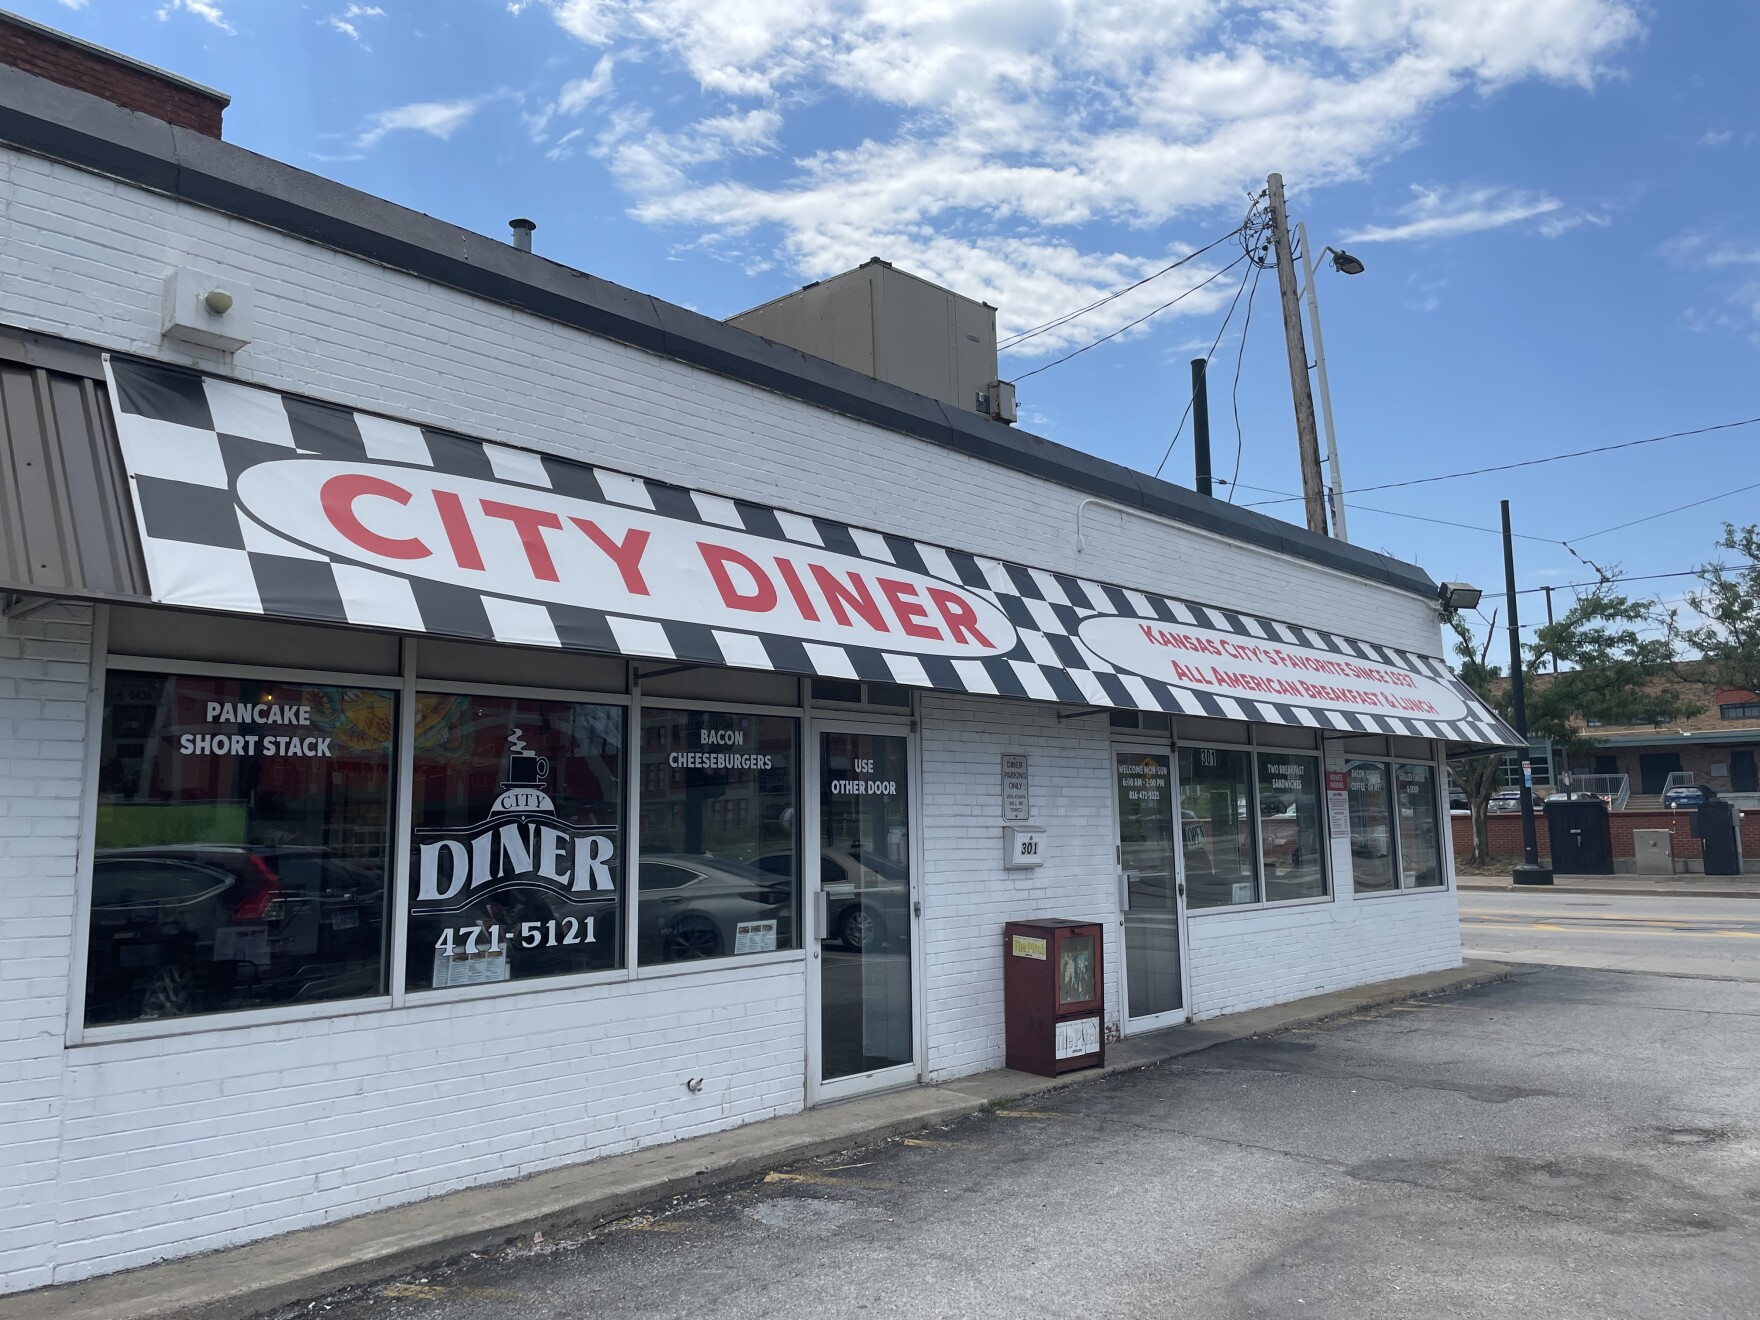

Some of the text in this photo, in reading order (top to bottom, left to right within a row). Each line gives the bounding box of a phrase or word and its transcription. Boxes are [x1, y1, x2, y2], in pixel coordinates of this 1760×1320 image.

[319, 473, 998, 650] CITY DINER
[1138, 623, 1222, 656] KANSAS
[1272, 649, 1350, 677] FAVORITE
[1344, 661, 1390, 683] SINCE
[1384, 670, 1418, 689] 1937
[1170, 659, 1440, 715] ALL AMERICAN BREAKFAST & LUNCH
[206, 701, 311, 726] PANCAKE
[179, 734, 332, 757] SHORT STACK
[700, 729, 744, 746] BACON
[668, 752, 772, 770] CHEESEBURGERS
[854, 758, 874, 773] USE
[1006, 761, 1023, 769] DINER
[1201, 749, 1216, 766] 301
[1003, 771, 1027, 780] PARKING
[1118, 765, 1168, 775] WELCOME MON-SUN
[1267, 764, 1305, 775] TWO BREAKFAST
[831, 780, 897, 795] OTHER DOOR
[1008, 782, 1023, 790] ONLY
[1134, 778, 1142, 787] AM
[1146, 778, 1156, 788] 2:00
[1157, 779, 1165, 788] PM
[1272, 779, 1302, 789] SANDWICHES
[1351, 782, 1366, 791] COFFEE
[500, 792, 546, 810] CITY
[1129, 791, 1160, 800] 816-471-5121
[1187, 824, 1206, 847] OPEN
[1021, 842, 1038, 855] 301
[416, 822, 615, 901] DINER
[435, 916, 597, 957] 471-5121
